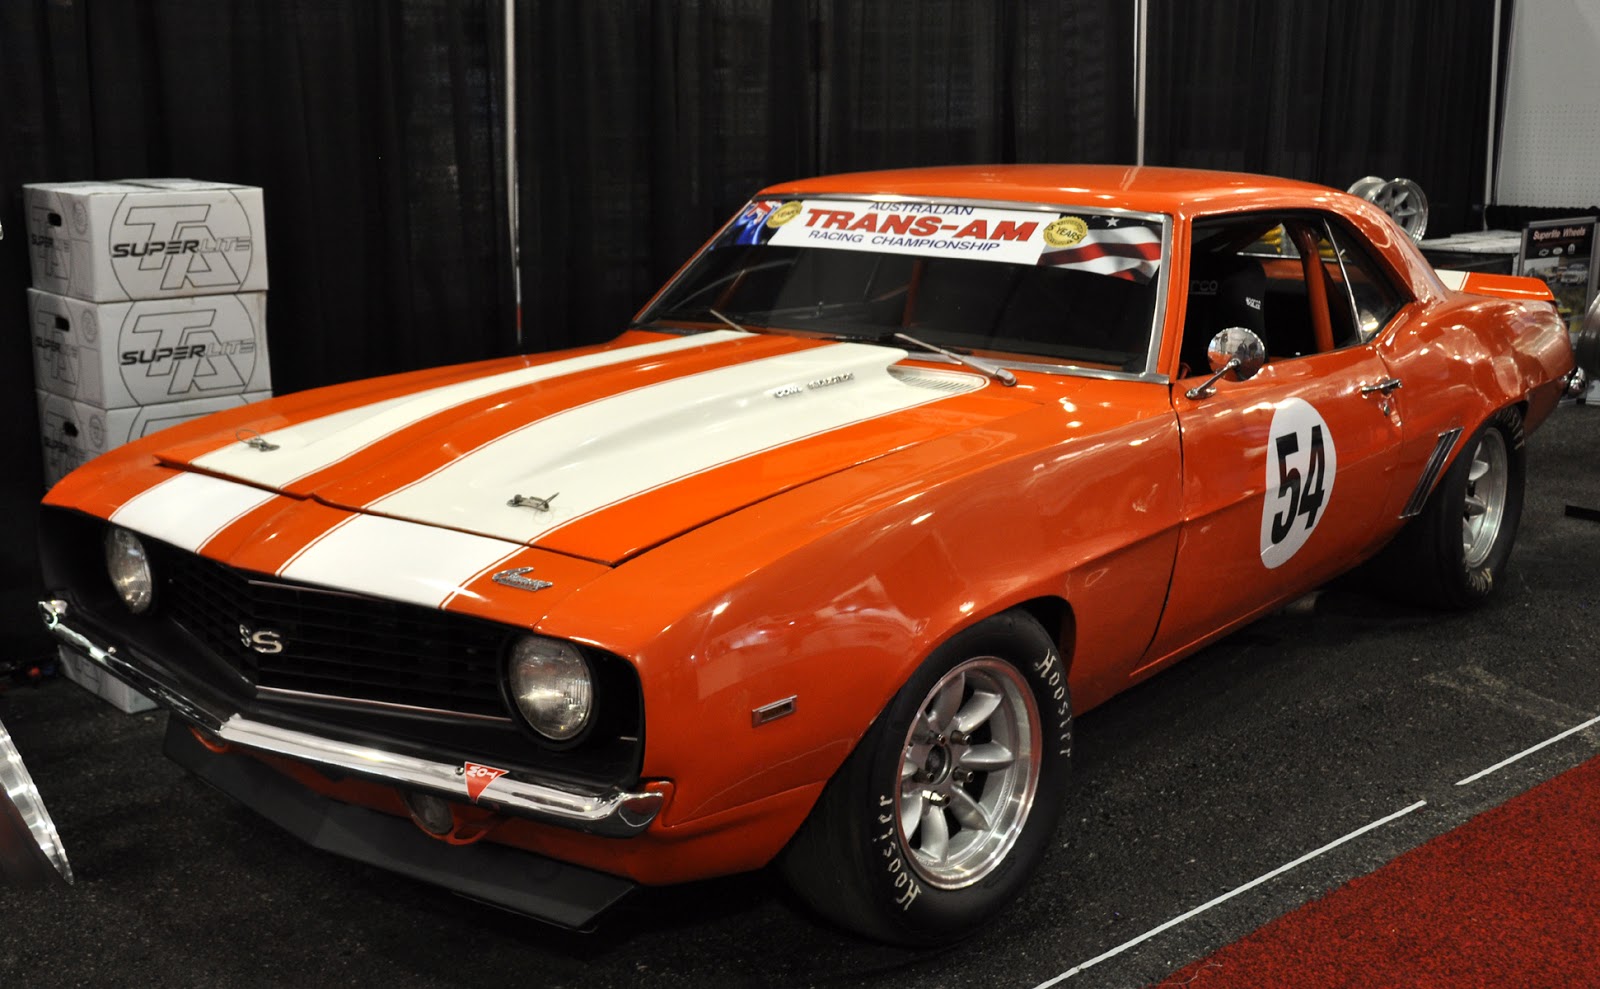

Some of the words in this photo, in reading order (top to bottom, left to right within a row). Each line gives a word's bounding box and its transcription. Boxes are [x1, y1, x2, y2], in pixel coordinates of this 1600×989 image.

[868, 202, 974, 216] AUSTRALIAN
[805, 208, 1039, 242] TRANS-AM
[1056, 226, 1082, 241] YEARS
[1562, 226, 1587, 237] Wheels
[111, 236, 251, 258] SUPERLITE
[808, 230, 864, 243] RACING
[871, 235, 1000, 251] CHAMPIONSHIP
[119, 339, 256, 366] SUPERLITE
[1271, 425, 1325, 545] 54
[239, 624, 283, 653] SS
[466, 765, 499, 780] TOW
